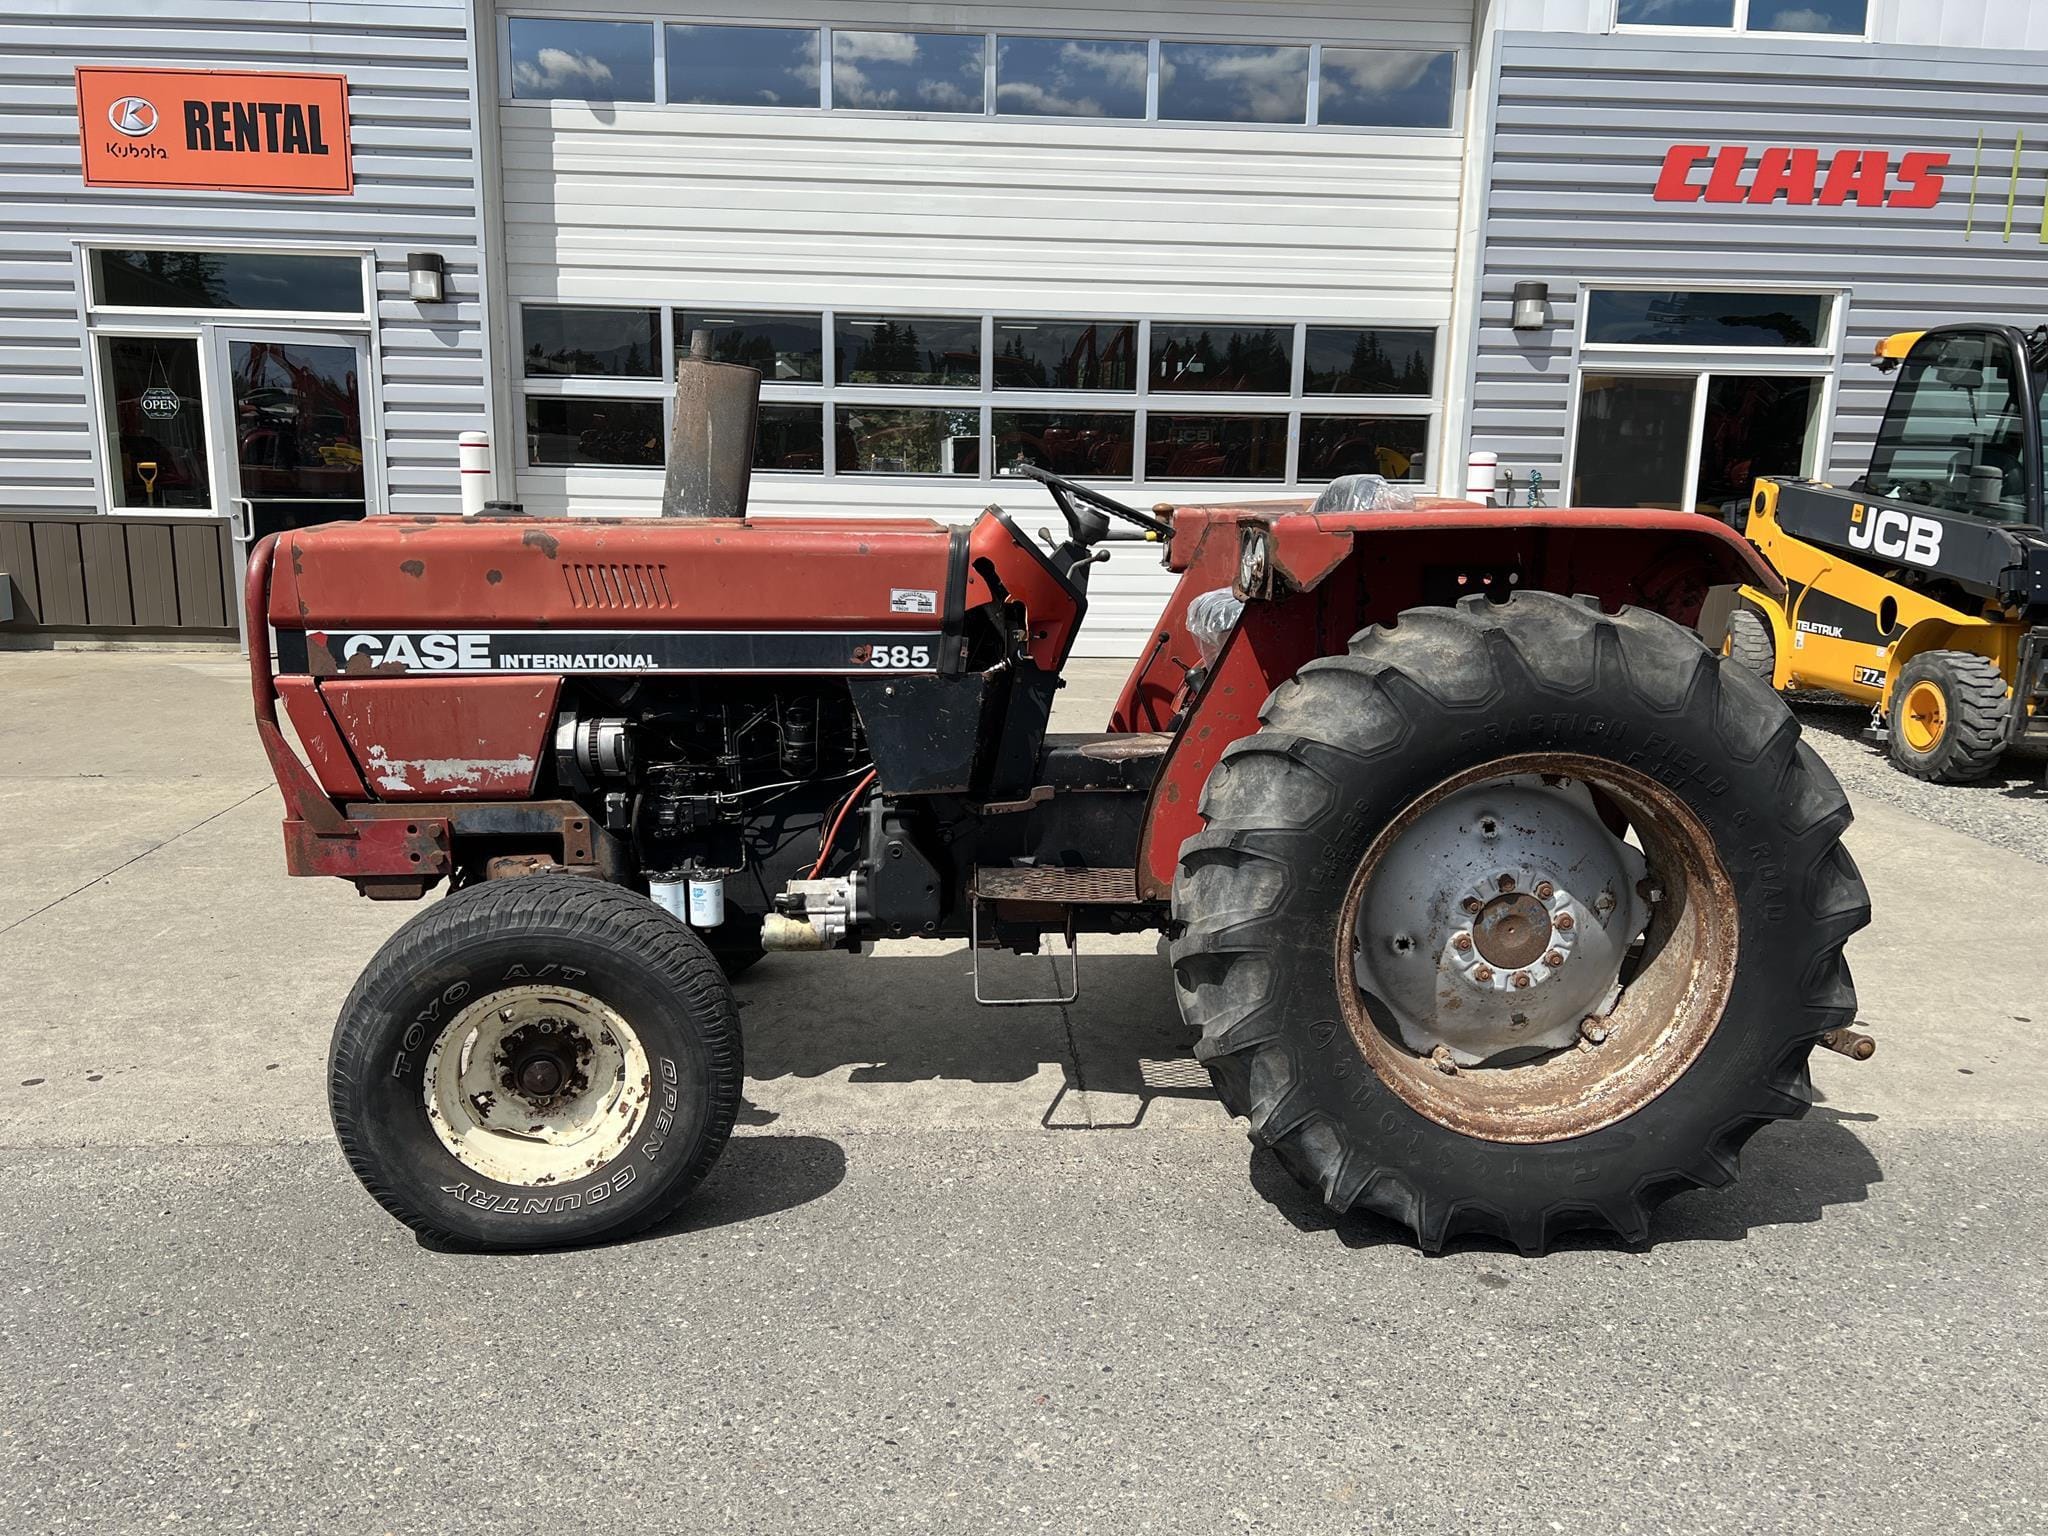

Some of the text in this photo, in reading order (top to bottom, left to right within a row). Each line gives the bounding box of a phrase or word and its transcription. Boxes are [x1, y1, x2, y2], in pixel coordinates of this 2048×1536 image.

[183, 99, 329, 155] RENTAL
[106, 142, 167, 159] Kubota
[1653, 144, 1951, 209] CLAAS
[142, 399, 178, 410] OPEN
[1848, 506, 1944, 567] JCB
[1796, 619, 1843, 638] TELETRUK
[343, 634, 659, 669] CASE INTERNATIONAL
[870, 645, 930, 668] 585
[1641, 730, 1731, 798] FIELD
[1748, 840, 1791, 923] ROAD
[502, 963, 587, 981] A/T
[391, 980, 471, 1079] TOYO
[440, 1056, 678, 1214] OPEN COUNTRY
